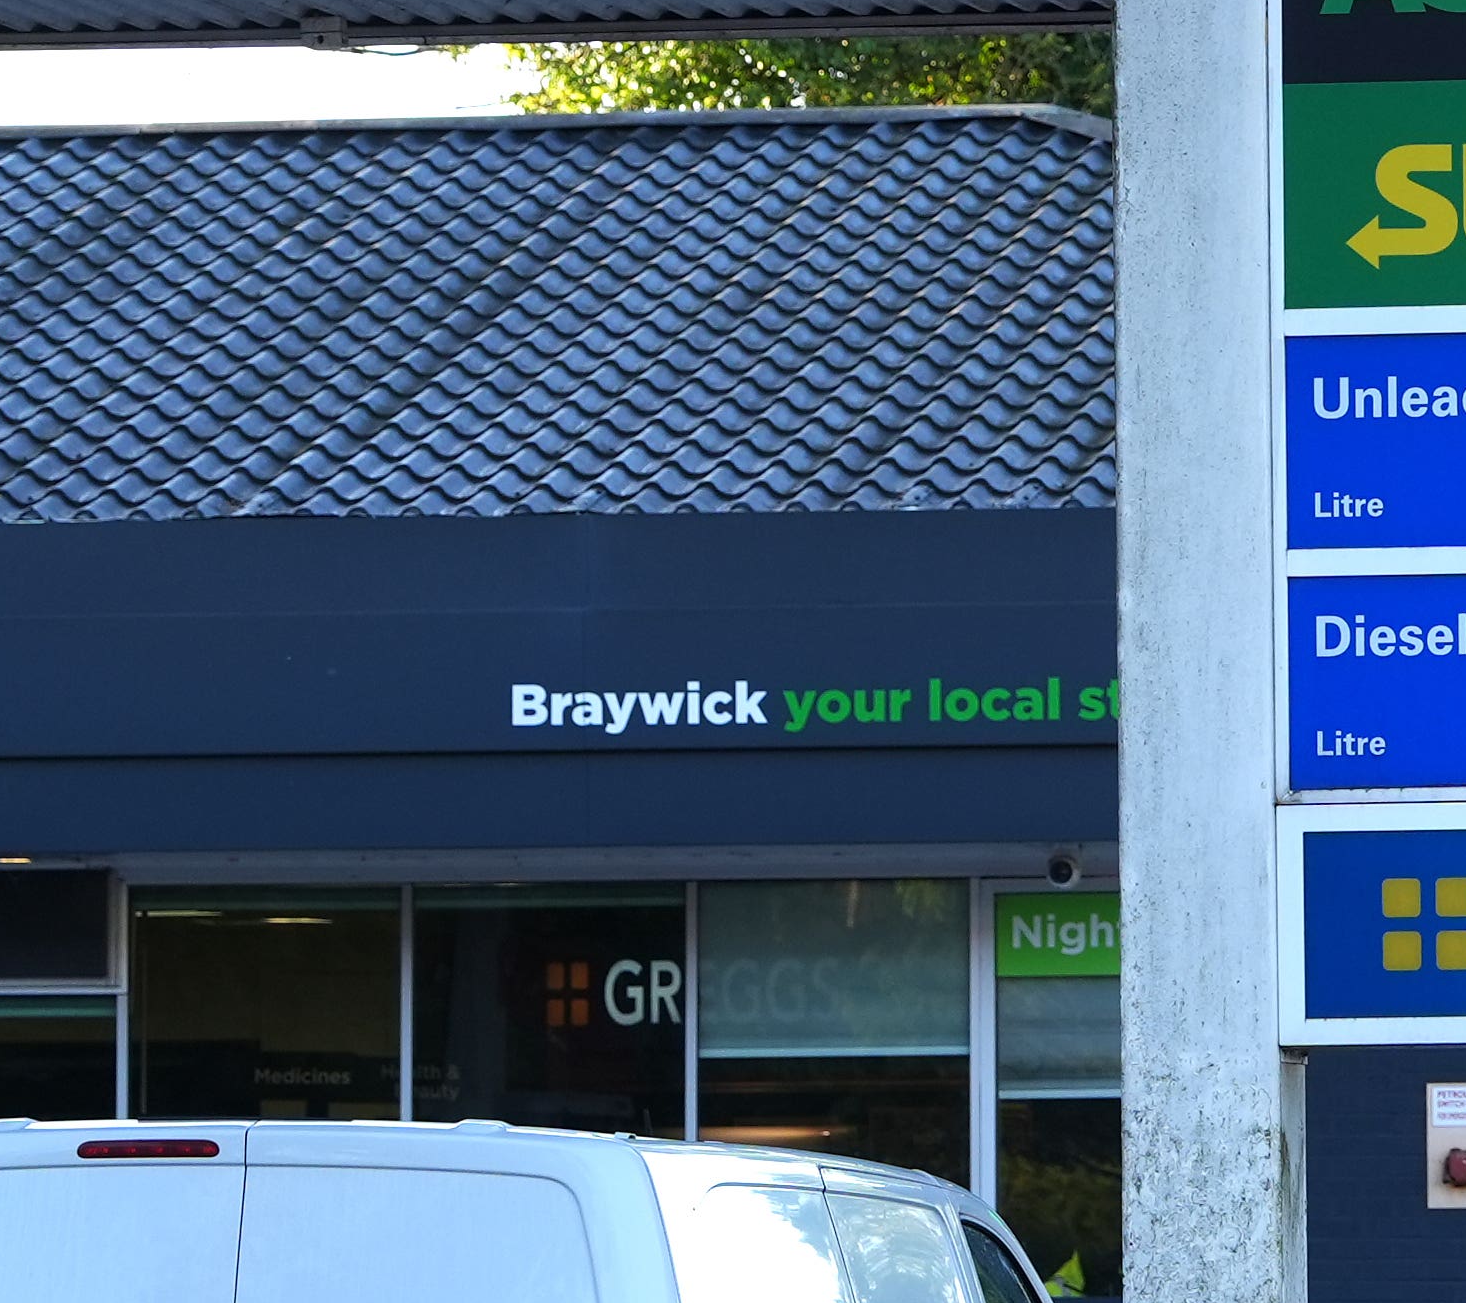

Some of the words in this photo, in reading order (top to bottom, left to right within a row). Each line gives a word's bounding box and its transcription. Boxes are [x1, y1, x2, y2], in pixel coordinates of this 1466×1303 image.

[1313, 491, 1384, 519] Litre
[510, 680, 768, 735] Braywick
[783, 686, 912, 732] your
[929, 677, 1062, 723] local
[1316, 730, 1387, 758] Litre
[1011, 914, 1121, 956] Nigh
[254, 1067, 352, 1086] Medicines
